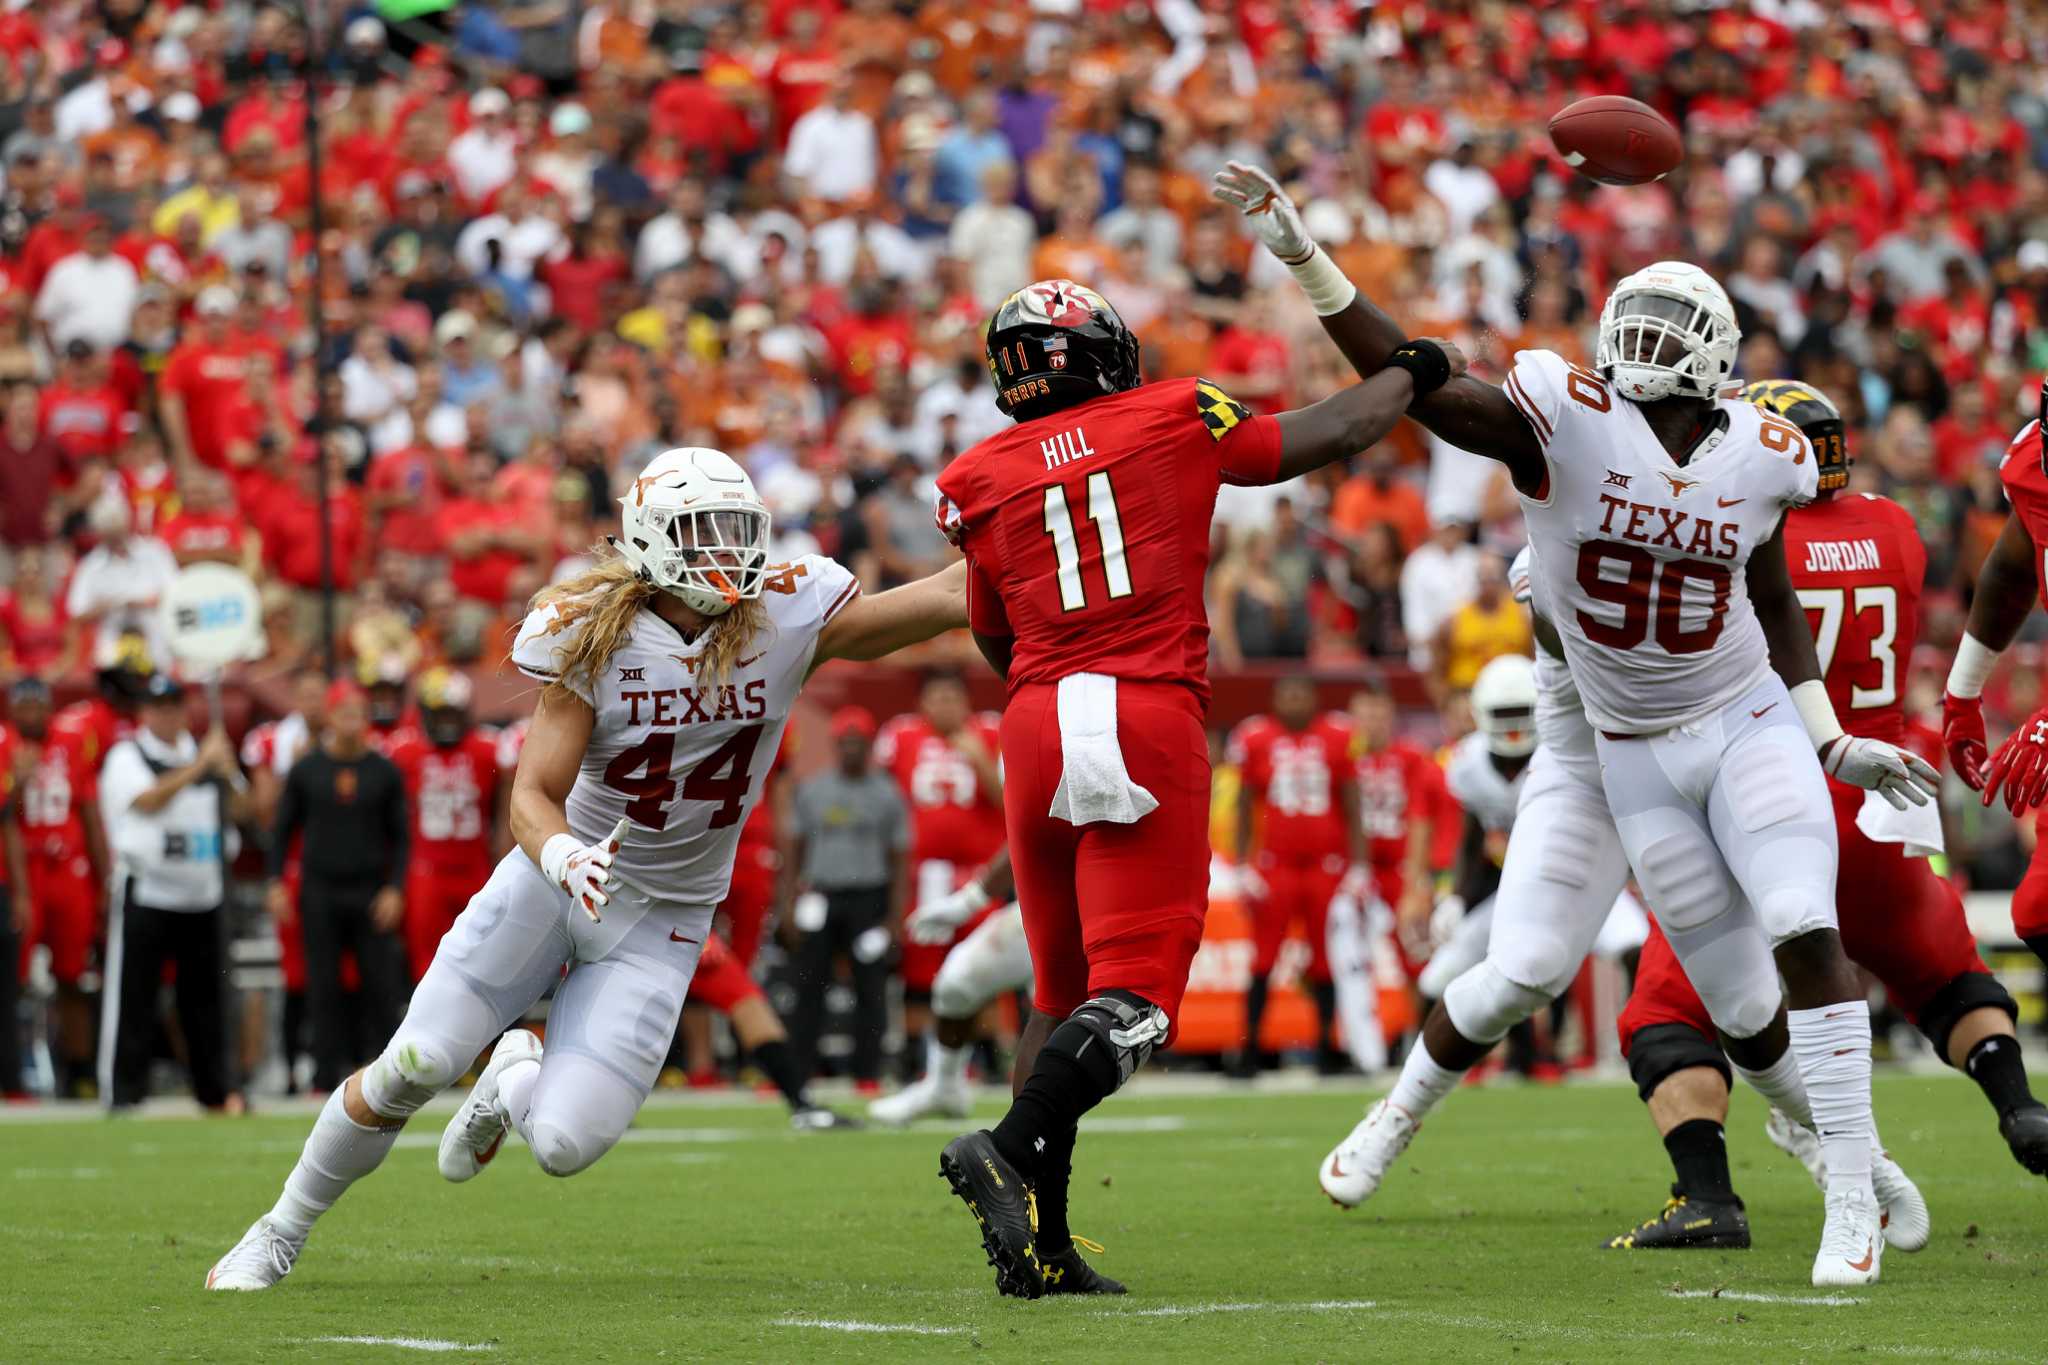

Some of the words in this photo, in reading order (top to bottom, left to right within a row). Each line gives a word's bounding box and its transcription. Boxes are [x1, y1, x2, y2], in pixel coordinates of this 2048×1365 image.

[1002, 341, 1030, 376] 11
[1050, 353, 1066, 367] 79
[1003, 378, 1050, 406] TERPS
[1040, 427, 1095, 470] HILL
[1755, 404, 1807, 465] 9
[1813, 434, 1841, 466] 73
[1044, 470, 1134, 613] 11
[1599, 493, 1739, 560] TEXAS
[1805, 539, 1881, 572] JORDAN
[1576, 538, 1732, 655] 90
[1793, 584, 1897, 709] 73
[621, 679, 766, 727] TEXAS
[603, 723, 765, 831] 44
